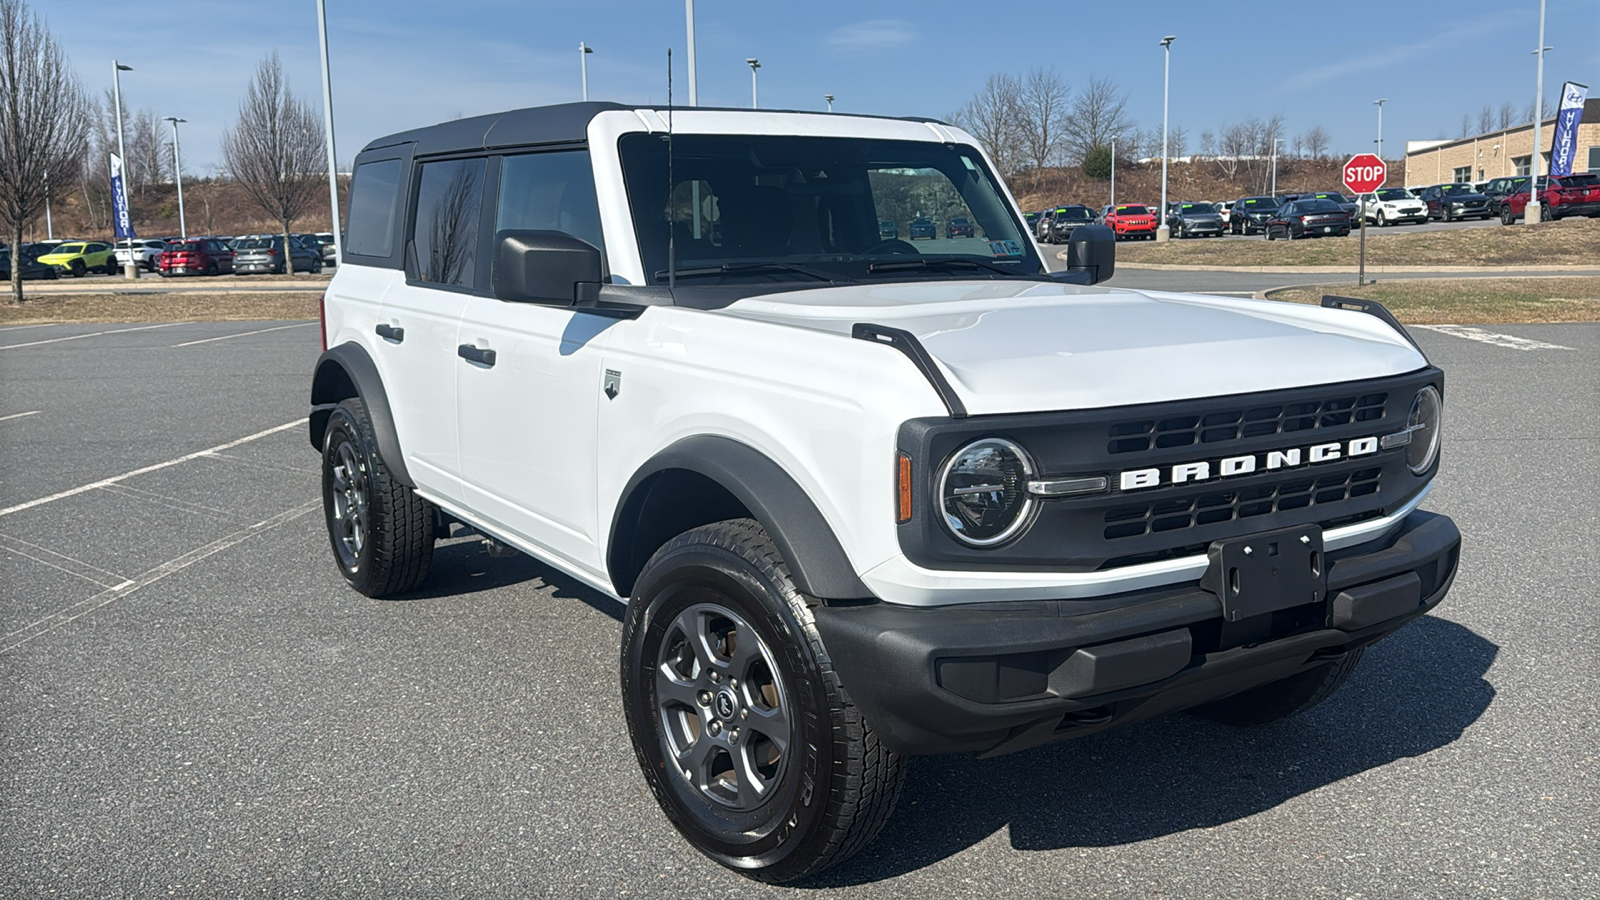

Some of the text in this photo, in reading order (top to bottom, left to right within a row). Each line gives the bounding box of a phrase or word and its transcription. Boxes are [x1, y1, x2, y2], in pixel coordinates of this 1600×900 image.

[1559, 111, 1576, 173] HYUNDAI
[1346, 166, 1383, 182] STOP
[1120, 436, 1378, 491] BRONCO
